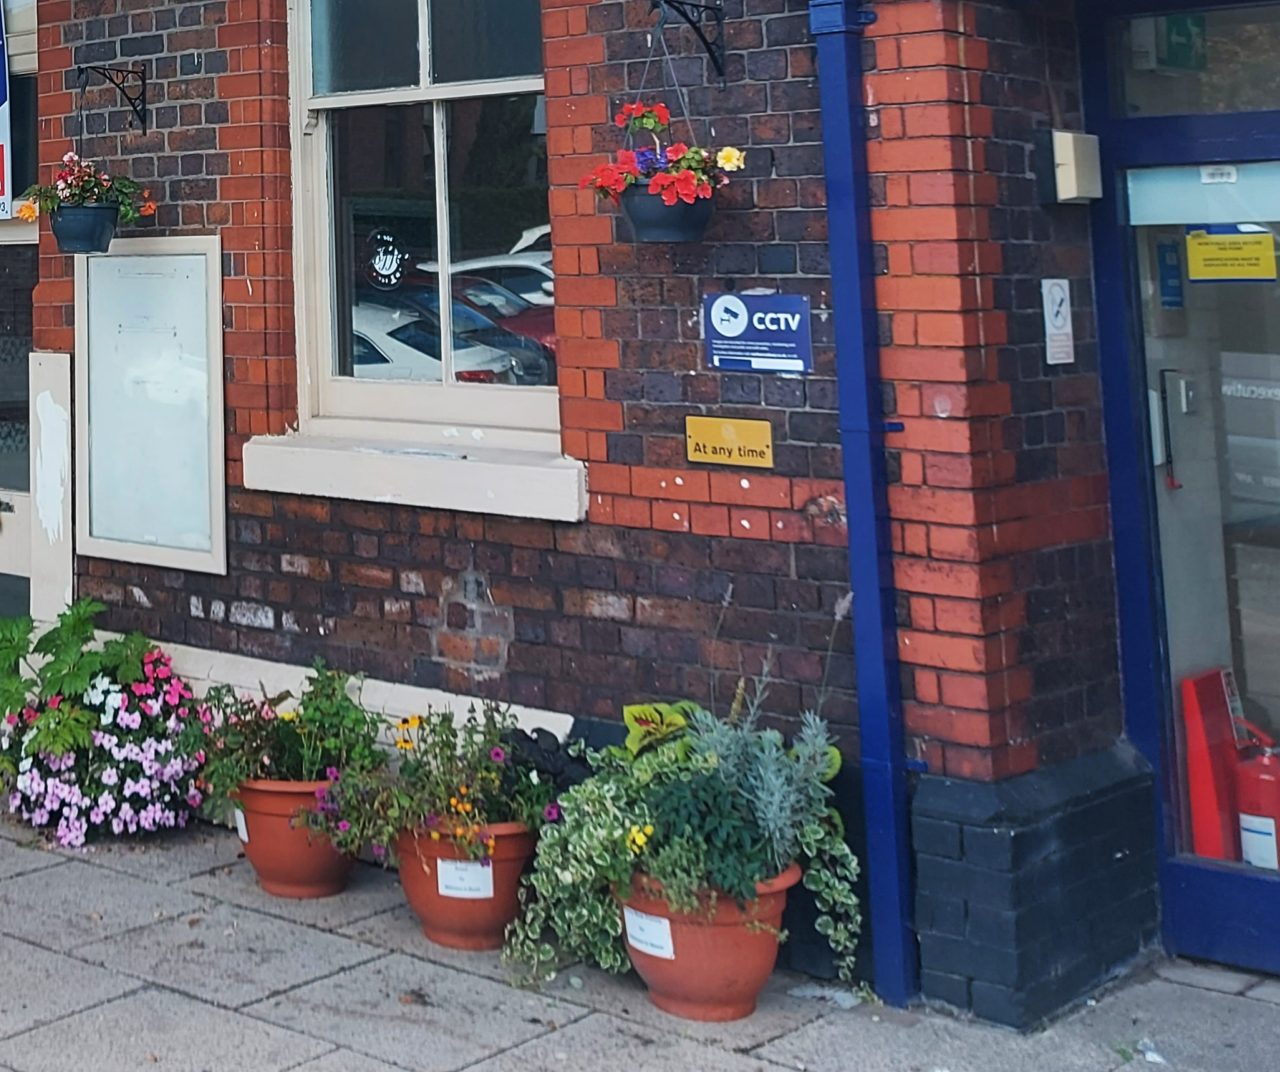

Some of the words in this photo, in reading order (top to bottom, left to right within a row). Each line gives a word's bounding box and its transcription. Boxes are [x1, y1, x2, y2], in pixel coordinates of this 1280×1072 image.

[752, 312, 801, 331] CCTV
[693, 442, 708, 454] At
[711, 445, 733, 458] any
[737, 446, 766, 458] time
